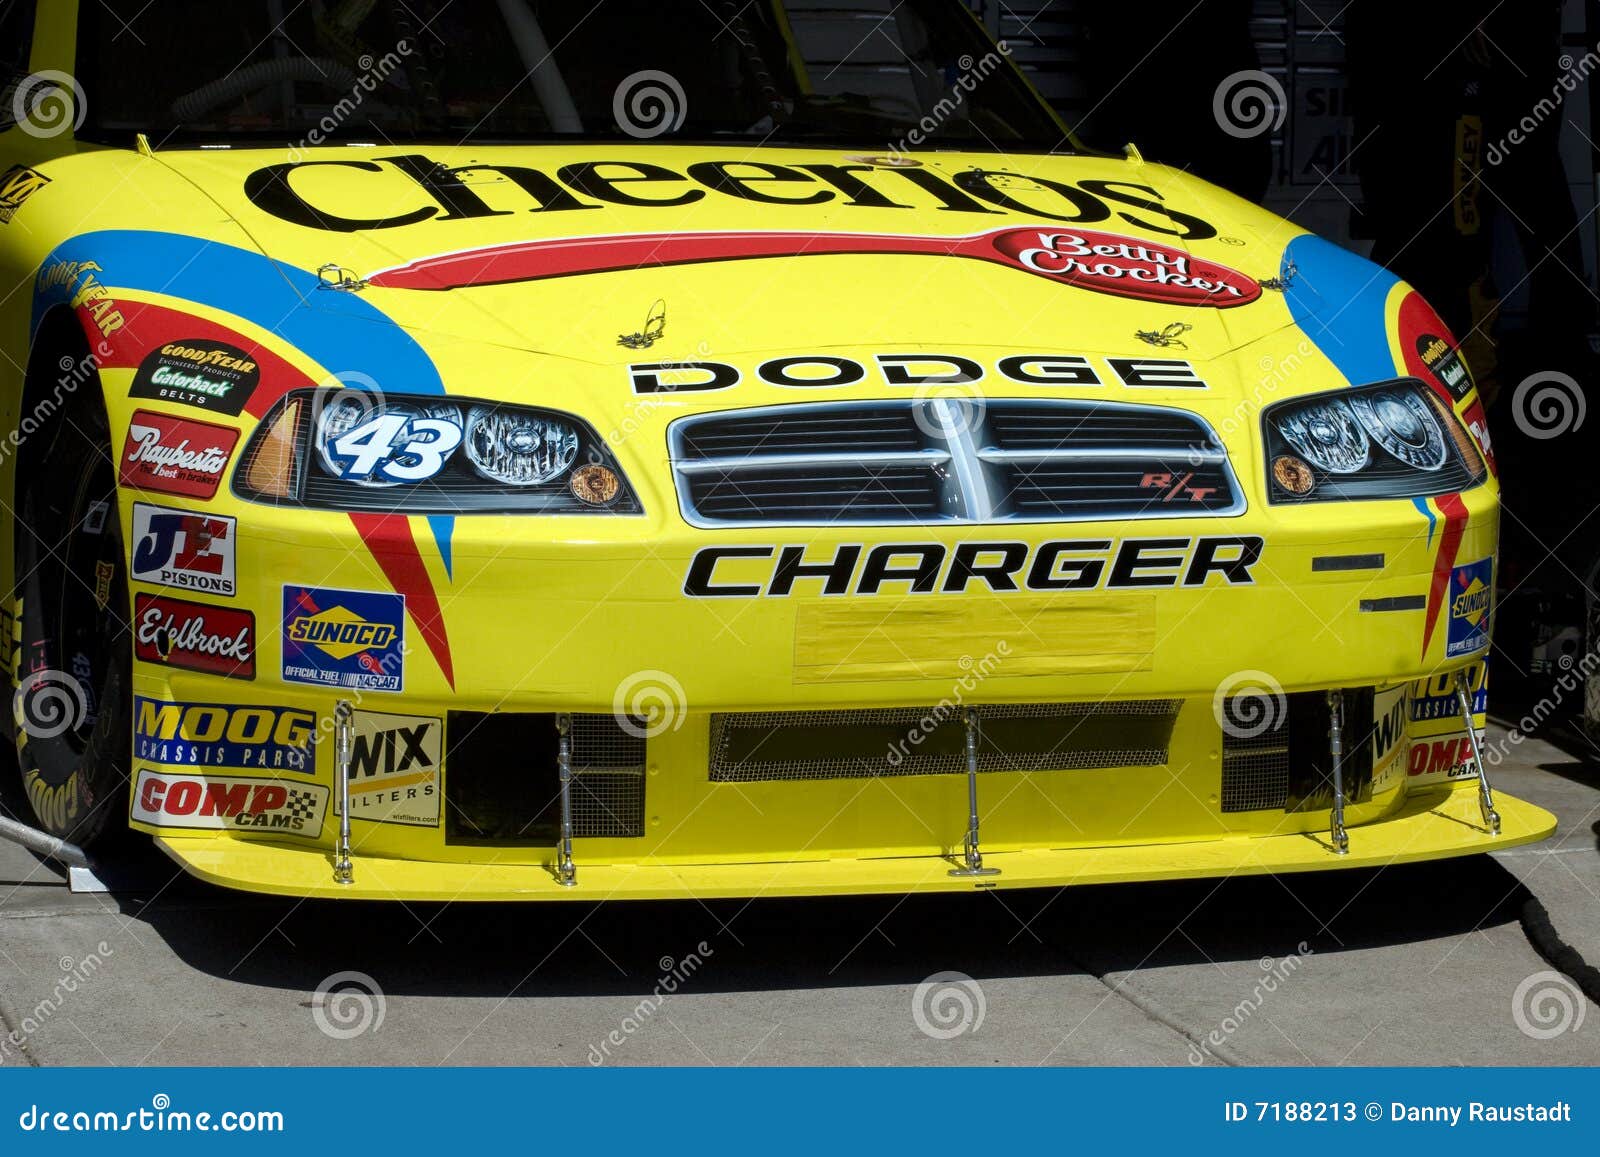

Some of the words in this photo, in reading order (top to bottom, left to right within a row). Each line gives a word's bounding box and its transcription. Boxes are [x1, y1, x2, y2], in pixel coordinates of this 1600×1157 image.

[244, 153, 1218, 241] Cheerios
[1038, 232, 1188, 274] Betty
[1018, 248, 1243, 297] Crocker
[161, 344, 256, 374] GOODYEAR
[628, 354, 1209, 395] DODGE
[151, 366, 235, 398] Gatorback
[160, 388, 207, 405] BELTS
[128, 424, 229, 475] Raybestos
[329, 412, 464, 483] 43
[158, 468, 178, 479] best
[1140, 472, 1218, 502] R/T
[133, 513, 229, 575] JE
[160, 570, 233, 594] PISTONS
[682, 535, 1264, 597] CHARGER
[138, 608, 250, 661] Edelbrock
[291, 617, 394, 647] SUNOCO
[285, 666, 318, 679] OFFICIAL
[320, 670, 340, 681] FUEL
[358, 673, 400, 690] NASCAR
[136, 701, 316, 748] MOOG
[140, 740, 225, 764] CHASSIS
[243, 748, 306, 770] PARTS
[1407, 736, 1480, 777] OMP
[1447, 763, 1479, 778] CAM
[140, 778, 288, 817] COMP
[339, 784, 434, 811] ILTERS
[234, 811, 305, 831] CAMS
